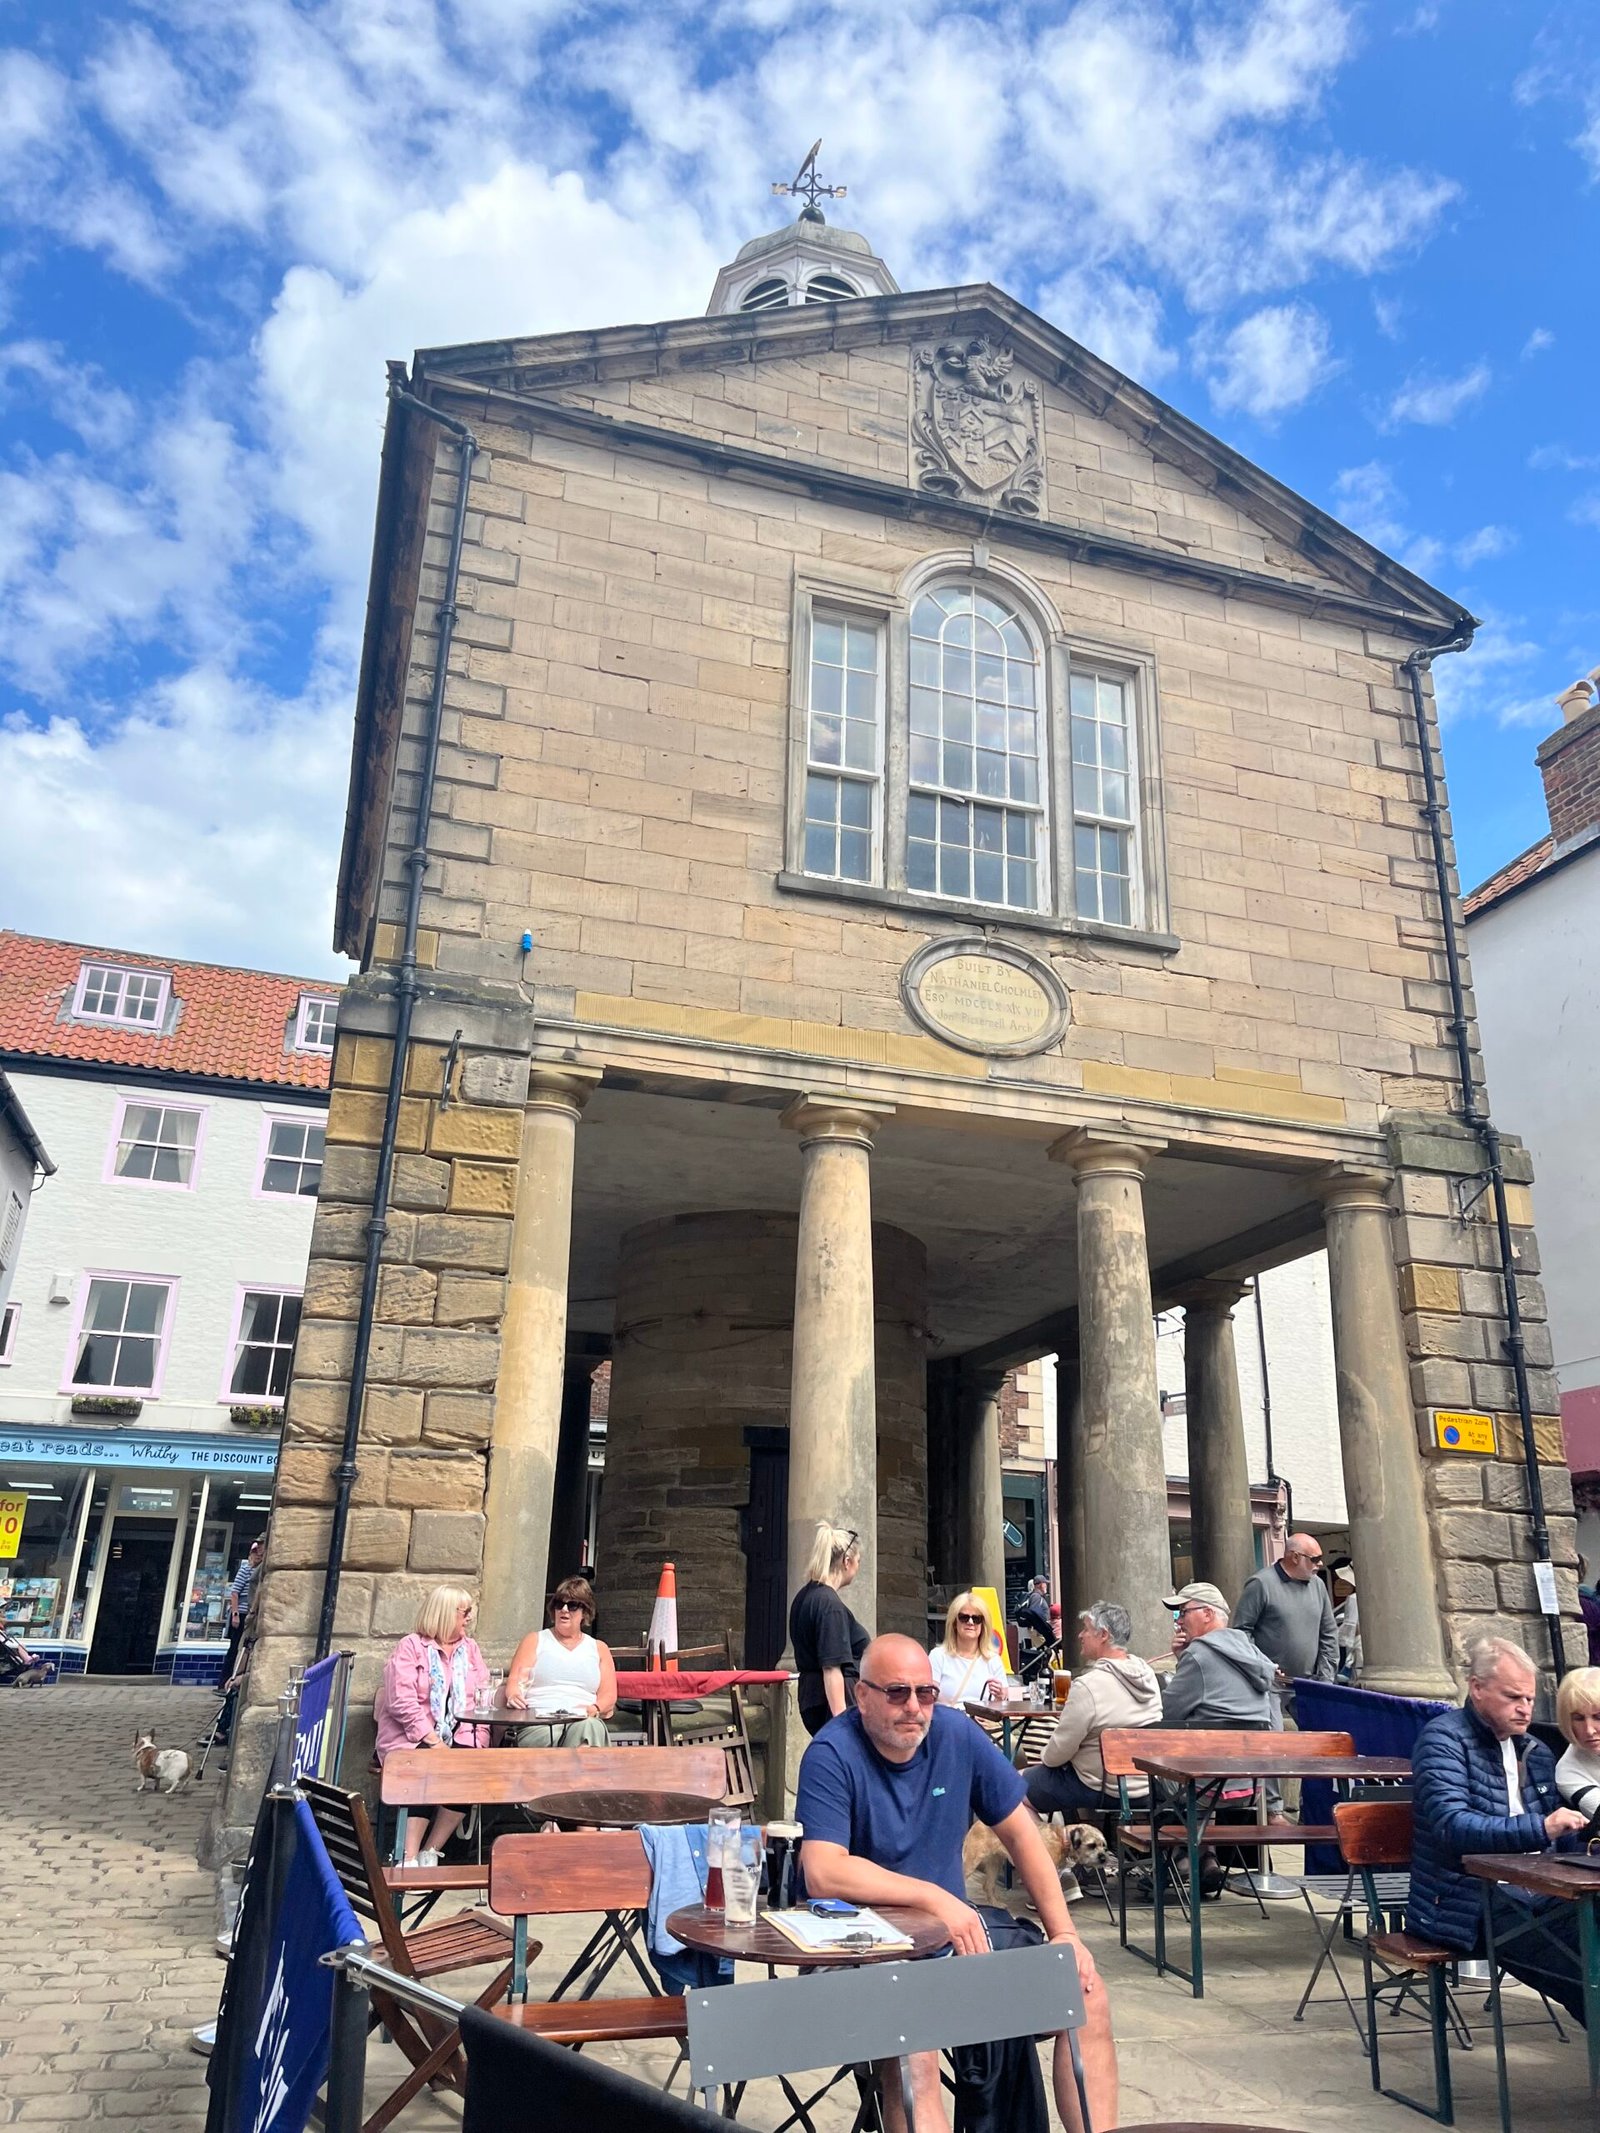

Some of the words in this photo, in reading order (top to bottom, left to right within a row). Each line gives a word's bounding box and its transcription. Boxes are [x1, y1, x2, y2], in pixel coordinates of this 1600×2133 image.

[957, 958, 991, 974] BUILT
[997, 965, 1012, 978] BY
[930, 971, 992, 993] NATHANIEL
[994, 982, 1043, 1000] CHOLMLEY
[1439, 1415, 1472, 1425] Pedestrian
[1474, 1418, 1489, 1426] Zone
[129, 1443, 179, 1464] Whitby
[191, 1451, 209, 1462] THE
[213, 1452, 264, 1464] DISCOUNT
